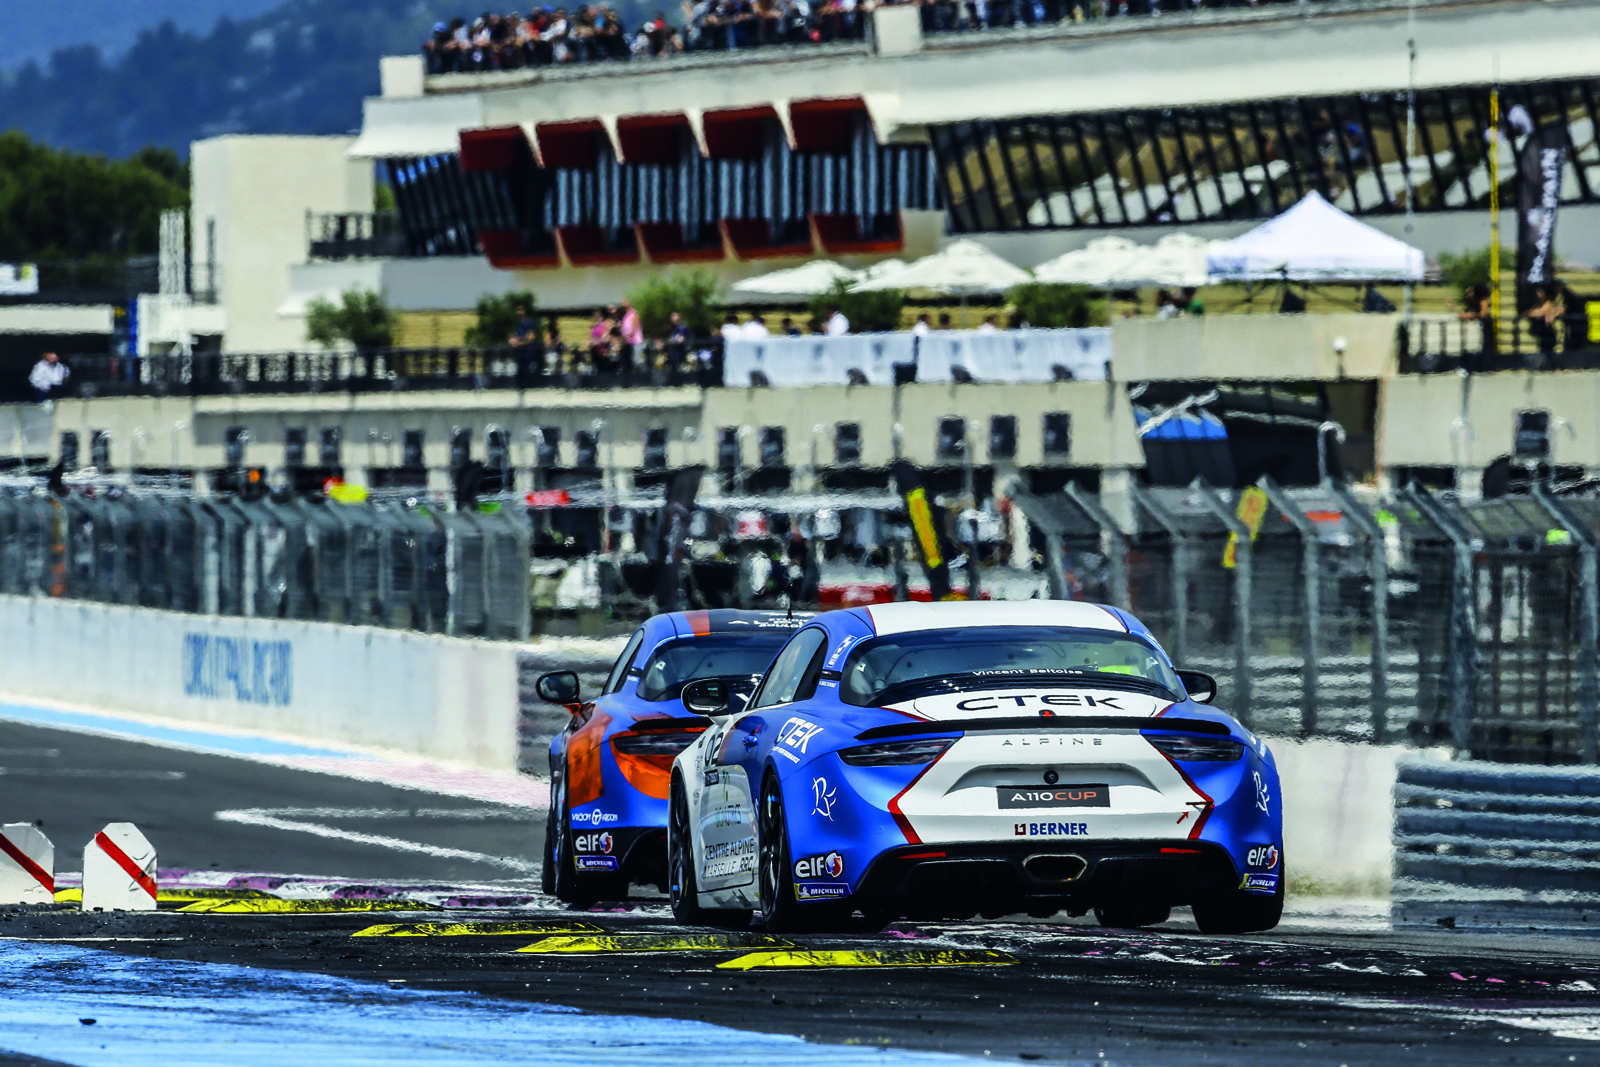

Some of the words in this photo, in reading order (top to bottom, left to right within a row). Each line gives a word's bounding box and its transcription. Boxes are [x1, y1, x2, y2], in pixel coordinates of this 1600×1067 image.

[956, 694, 1125, 711] CTEK
[776, 716, 825, 755] CTEK
[1001, 737, 1103, 746] ALPINE
[704, 731, 724, 767] 02
[1029, 822, 1089, 836] BERNER
[574, 833, 599, 852] elf
[704, 842, 730, 860] CENTRE
[730, 838, 755, 857] ALPINE
[1246, 846, 1267, 867] elf
[794, 856, 825, 878] elf
[810, 887, 845, 895] MICHELIN
[1250, 878, 1276, 888] MICHELIN
